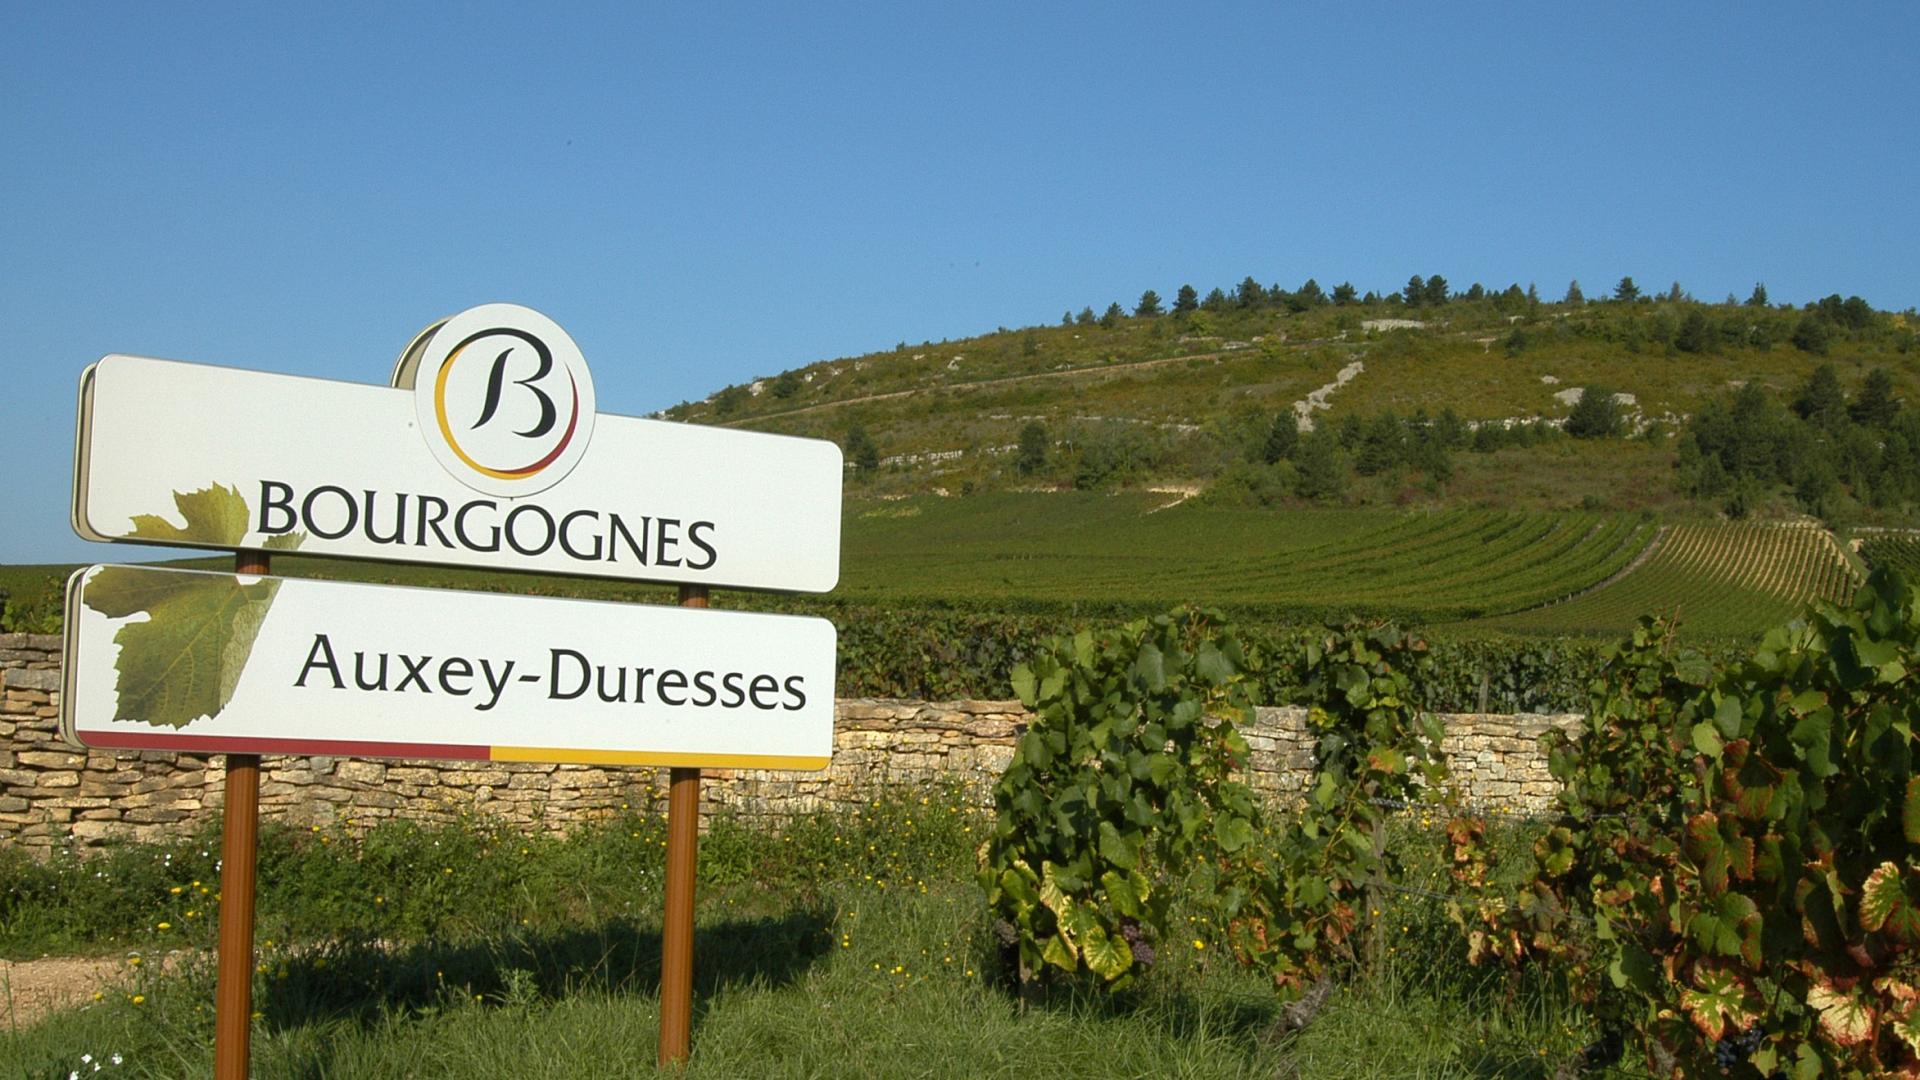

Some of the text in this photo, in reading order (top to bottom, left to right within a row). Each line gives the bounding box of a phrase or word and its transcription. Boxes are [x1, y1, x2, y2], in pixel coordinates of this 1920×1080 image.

[439, 327, 558, 439] B
[257, 479, 718, 570] BOURGOGNES
[294, 633, 807, 712] Auxey-Duresses
